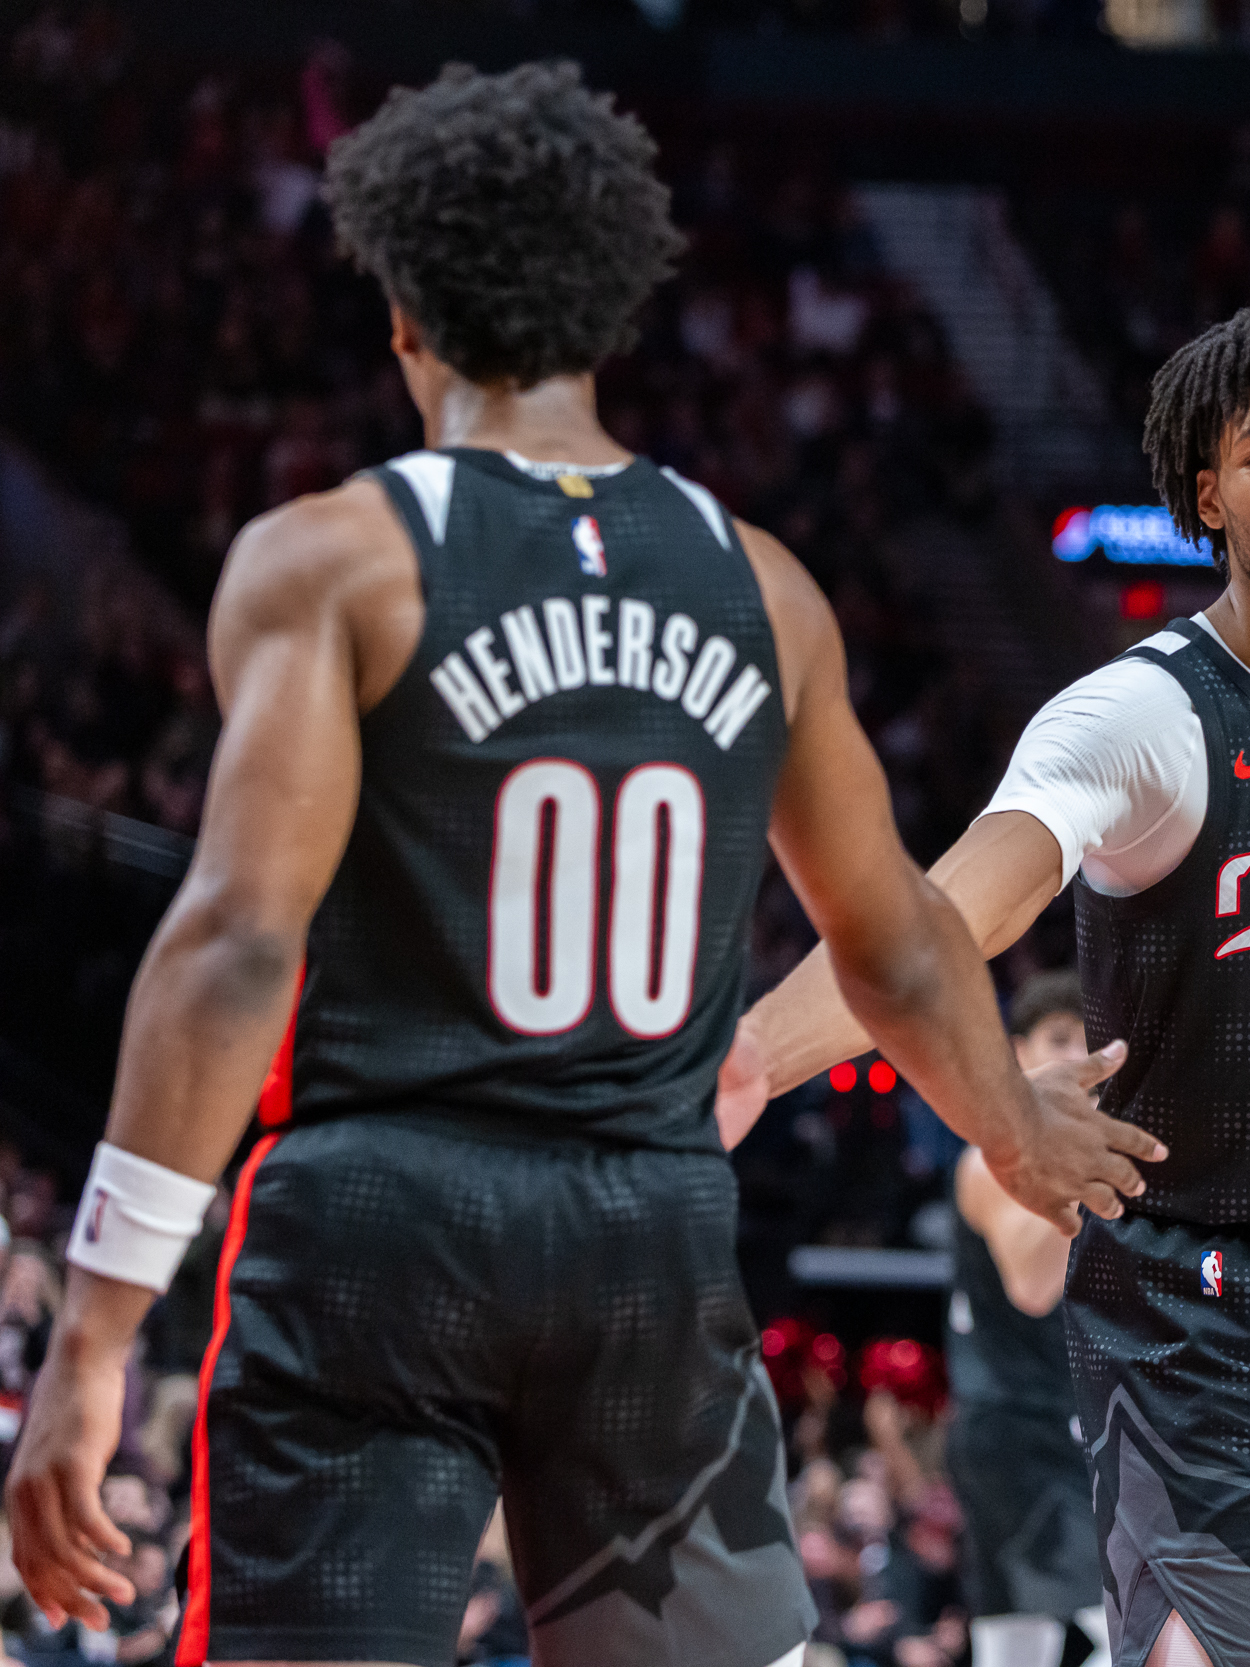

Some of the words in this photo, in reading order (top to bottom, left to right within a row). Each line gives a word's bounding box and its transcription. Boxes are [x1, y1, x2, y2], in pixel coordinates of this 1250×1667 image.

[429, 594, 772, 752] HENDERSON
[486, 756, 706, 1040] 00
[1203, 1287, 1215, 1296] NBA
